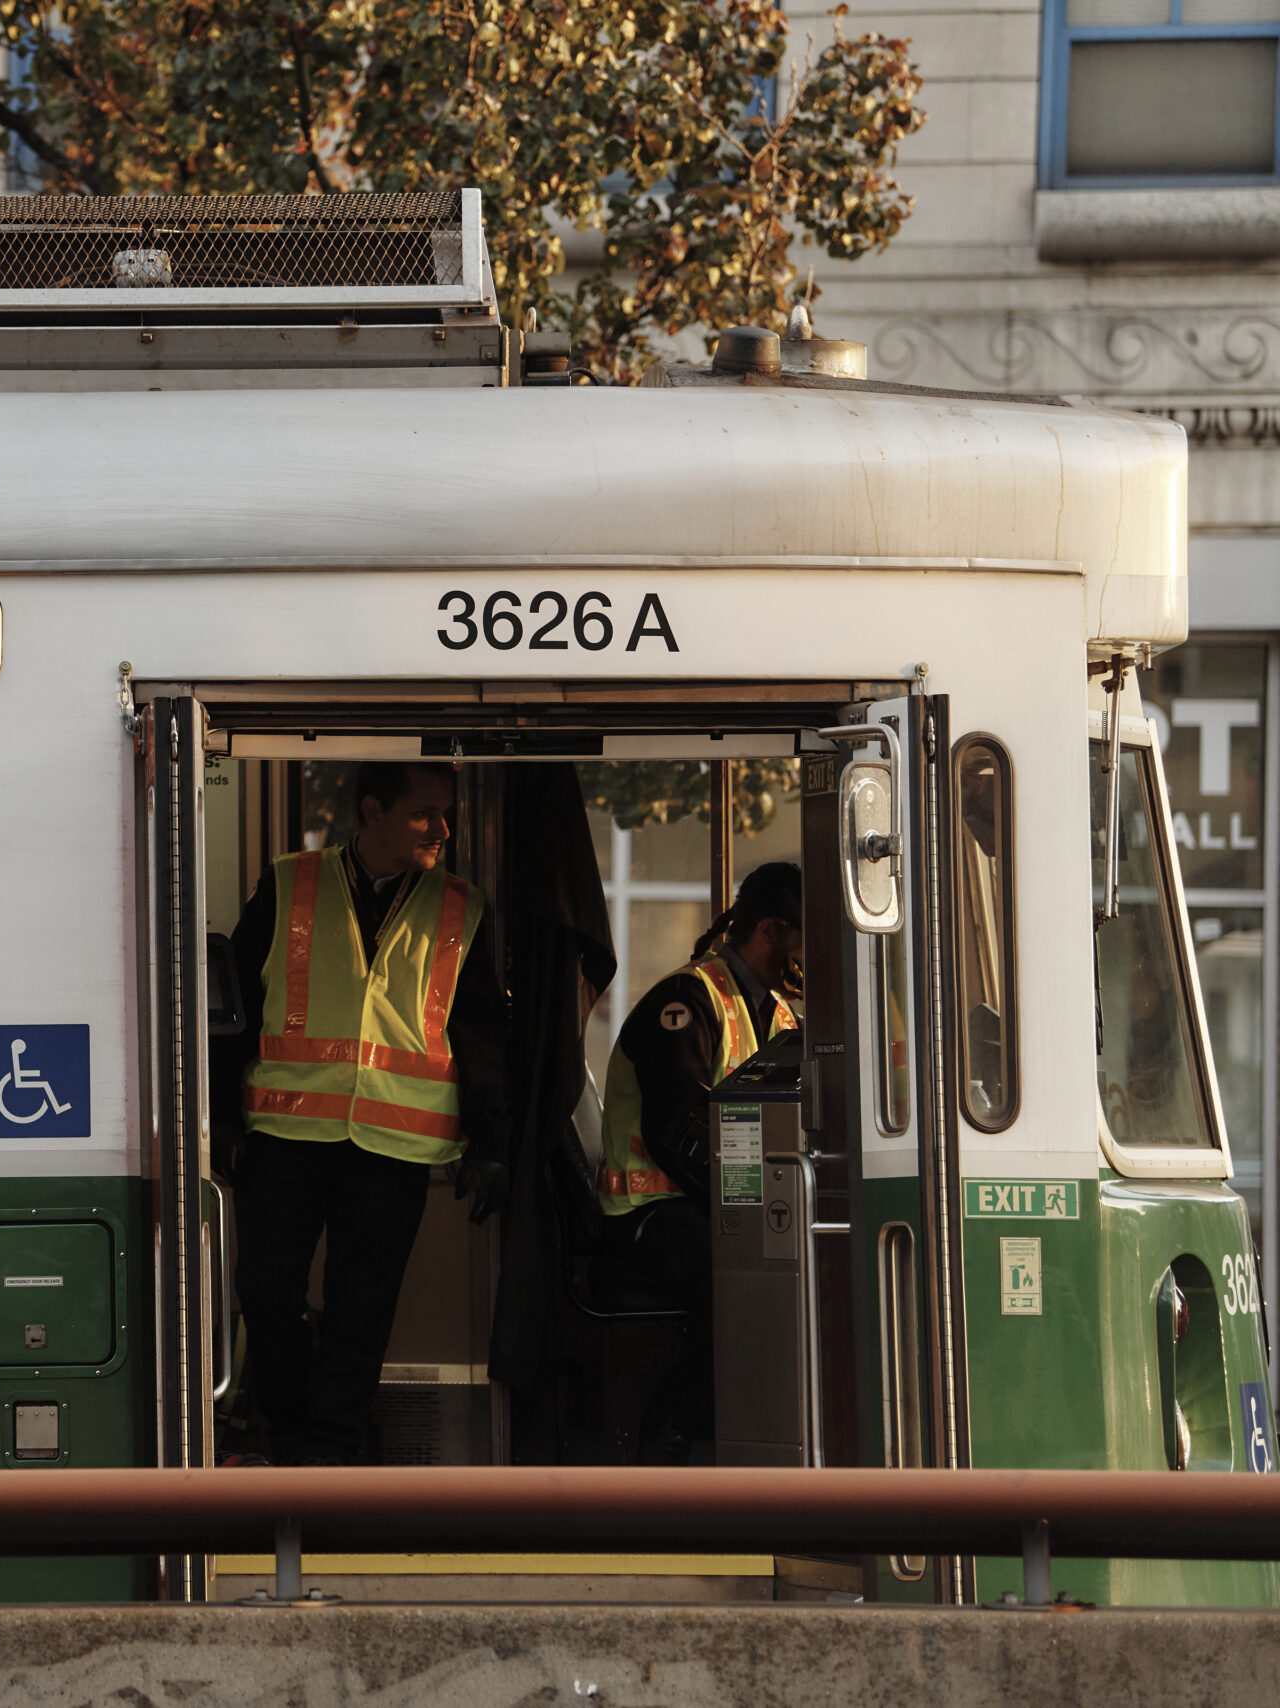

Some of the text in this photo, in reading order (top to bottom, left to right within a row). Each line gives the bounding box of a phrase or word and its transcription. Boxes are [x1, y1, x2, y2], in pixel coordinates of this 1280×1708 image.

[436, 590, 680, 652] 3626 A
[664, 1010, 685, 1026] T
[978, 1185, 1036, 1212] EXIT
[770, 1208, 788, 1228] T
